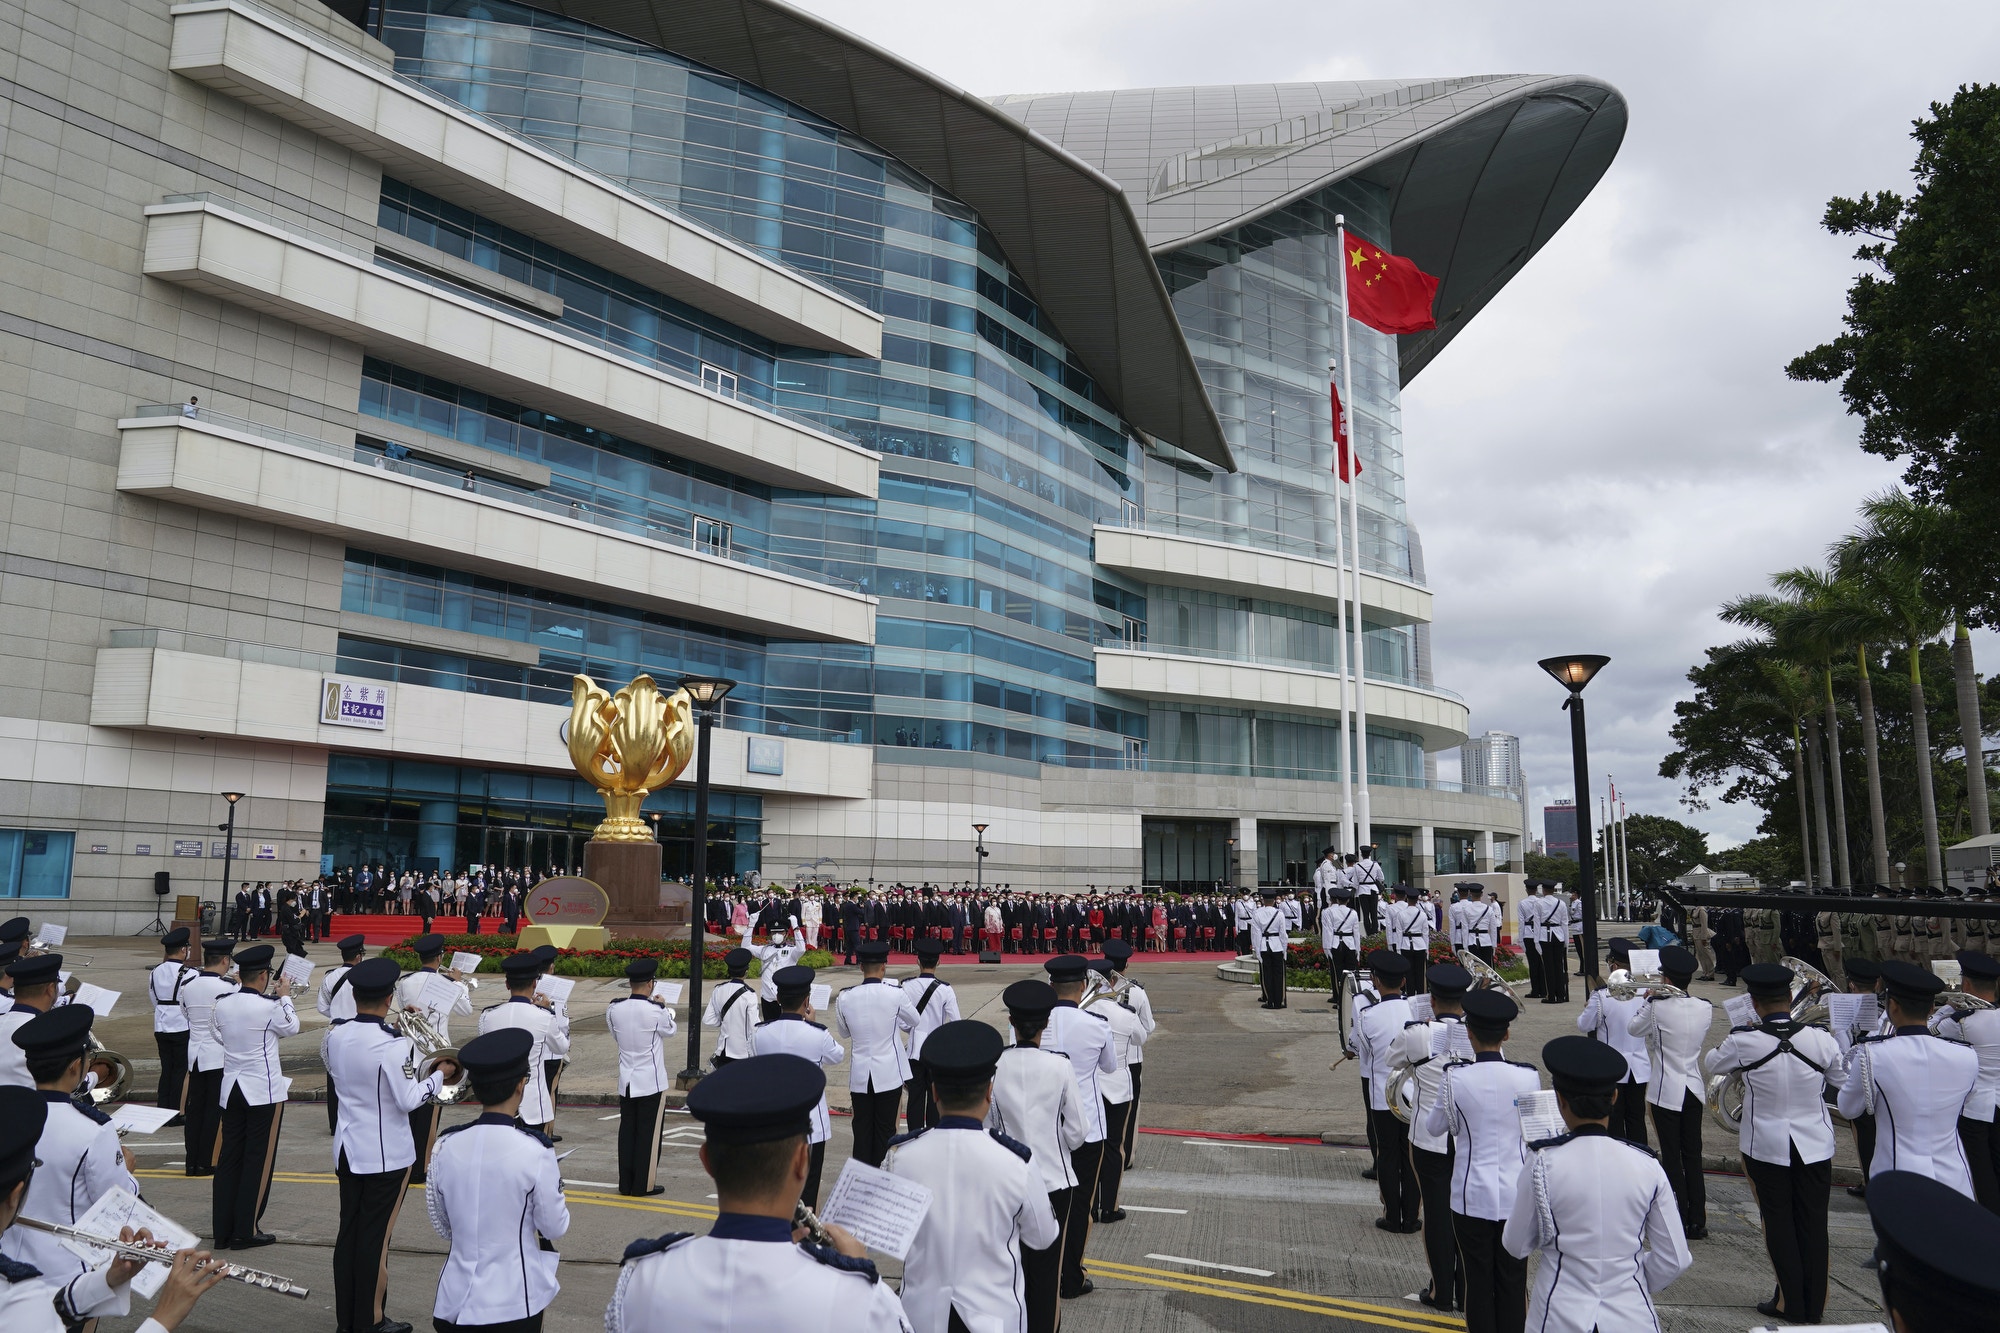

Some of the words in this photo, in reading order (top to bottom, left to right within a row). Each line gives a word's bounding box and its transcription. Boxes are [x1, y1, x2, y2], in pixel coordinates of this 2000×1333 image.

[343, 684, 385, 704] 金紫荊
[535, 897, 561, 916] 25
